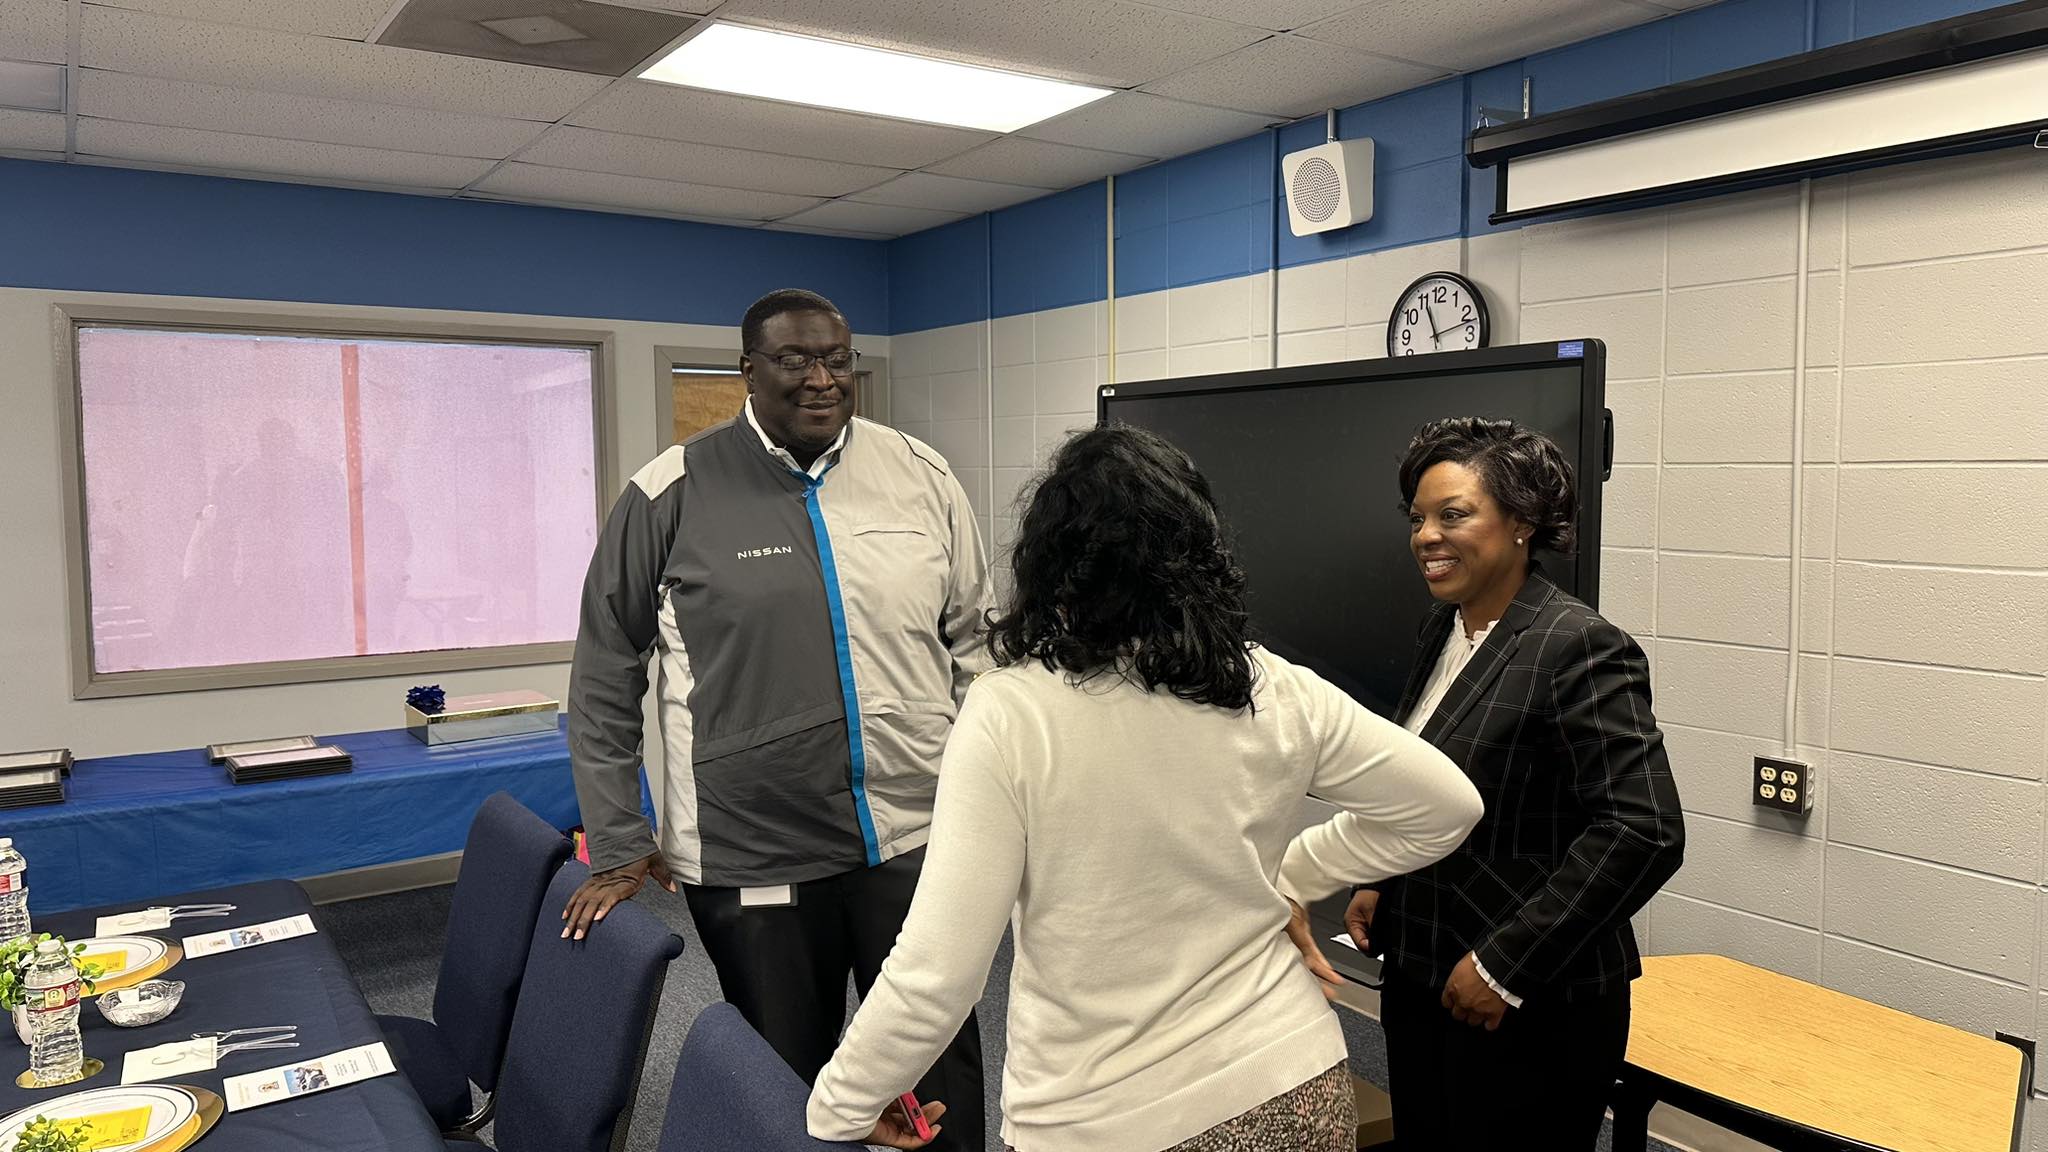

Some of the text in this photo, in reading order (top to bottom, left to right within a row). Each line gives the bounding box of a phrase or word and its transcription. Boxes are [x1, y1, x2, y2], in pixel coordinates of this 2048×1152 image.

[1418, 293, 1429, 310] 11
[1432, 286, 1447, 303] 12
[1452, 290, 1458, 307] 1
[1404, 308, 1419, 325] 10
[1461, 305, 1472, 322] 2
[1401, 329, 1411, 346] 9
[1464, 325, 1475, 343] 3
[737, 546, 792, 560] NISSAN
